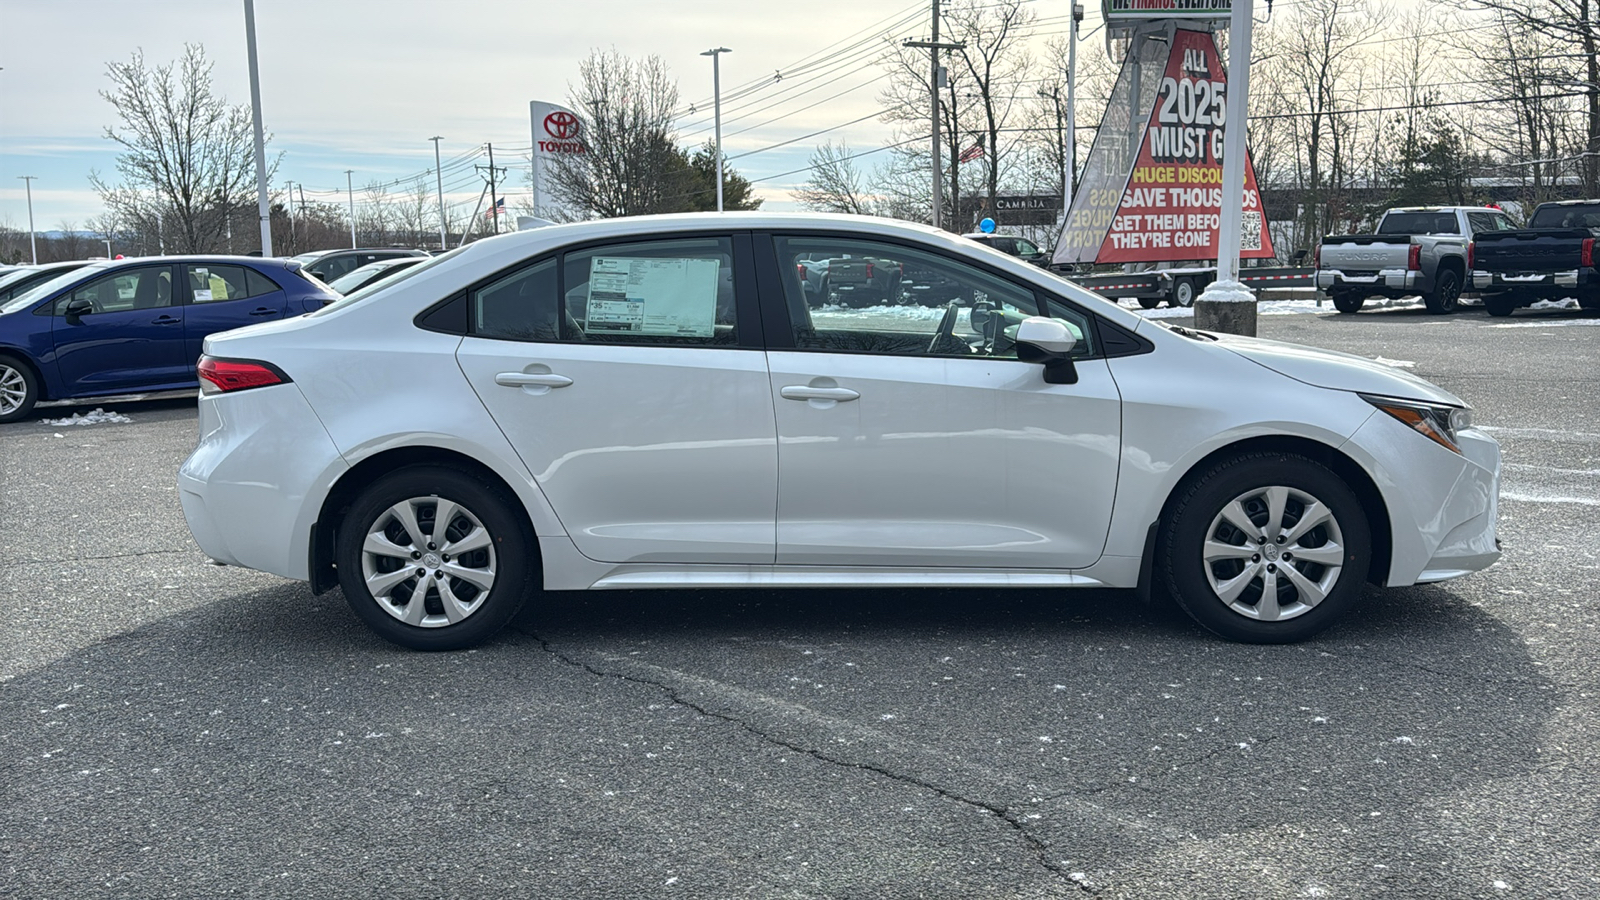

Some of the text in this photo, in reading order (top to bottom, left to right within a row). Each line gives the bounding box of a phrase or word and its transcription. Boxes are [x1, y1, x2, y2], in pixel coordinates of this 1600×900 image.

[1183, 48, 1208, 73] ALL
[1158, 77, 1226, 126] 2025
[537, 141, 586, 154] TOYOTA
[1150, 126, 1224, 159] MUST G
[1132, 167, 1175, 183] HUGE
[996, 199, 1045, 209] CAMBRIA
[1121, 187, 1257, 209] SAVE THOUSDS
[1111, 213, 1220, 232] GET THEM BEFO
[1110, 231, 1211, 249] THEY'RE GONE
[1337, 252, 1389, 261] TUNDRA
